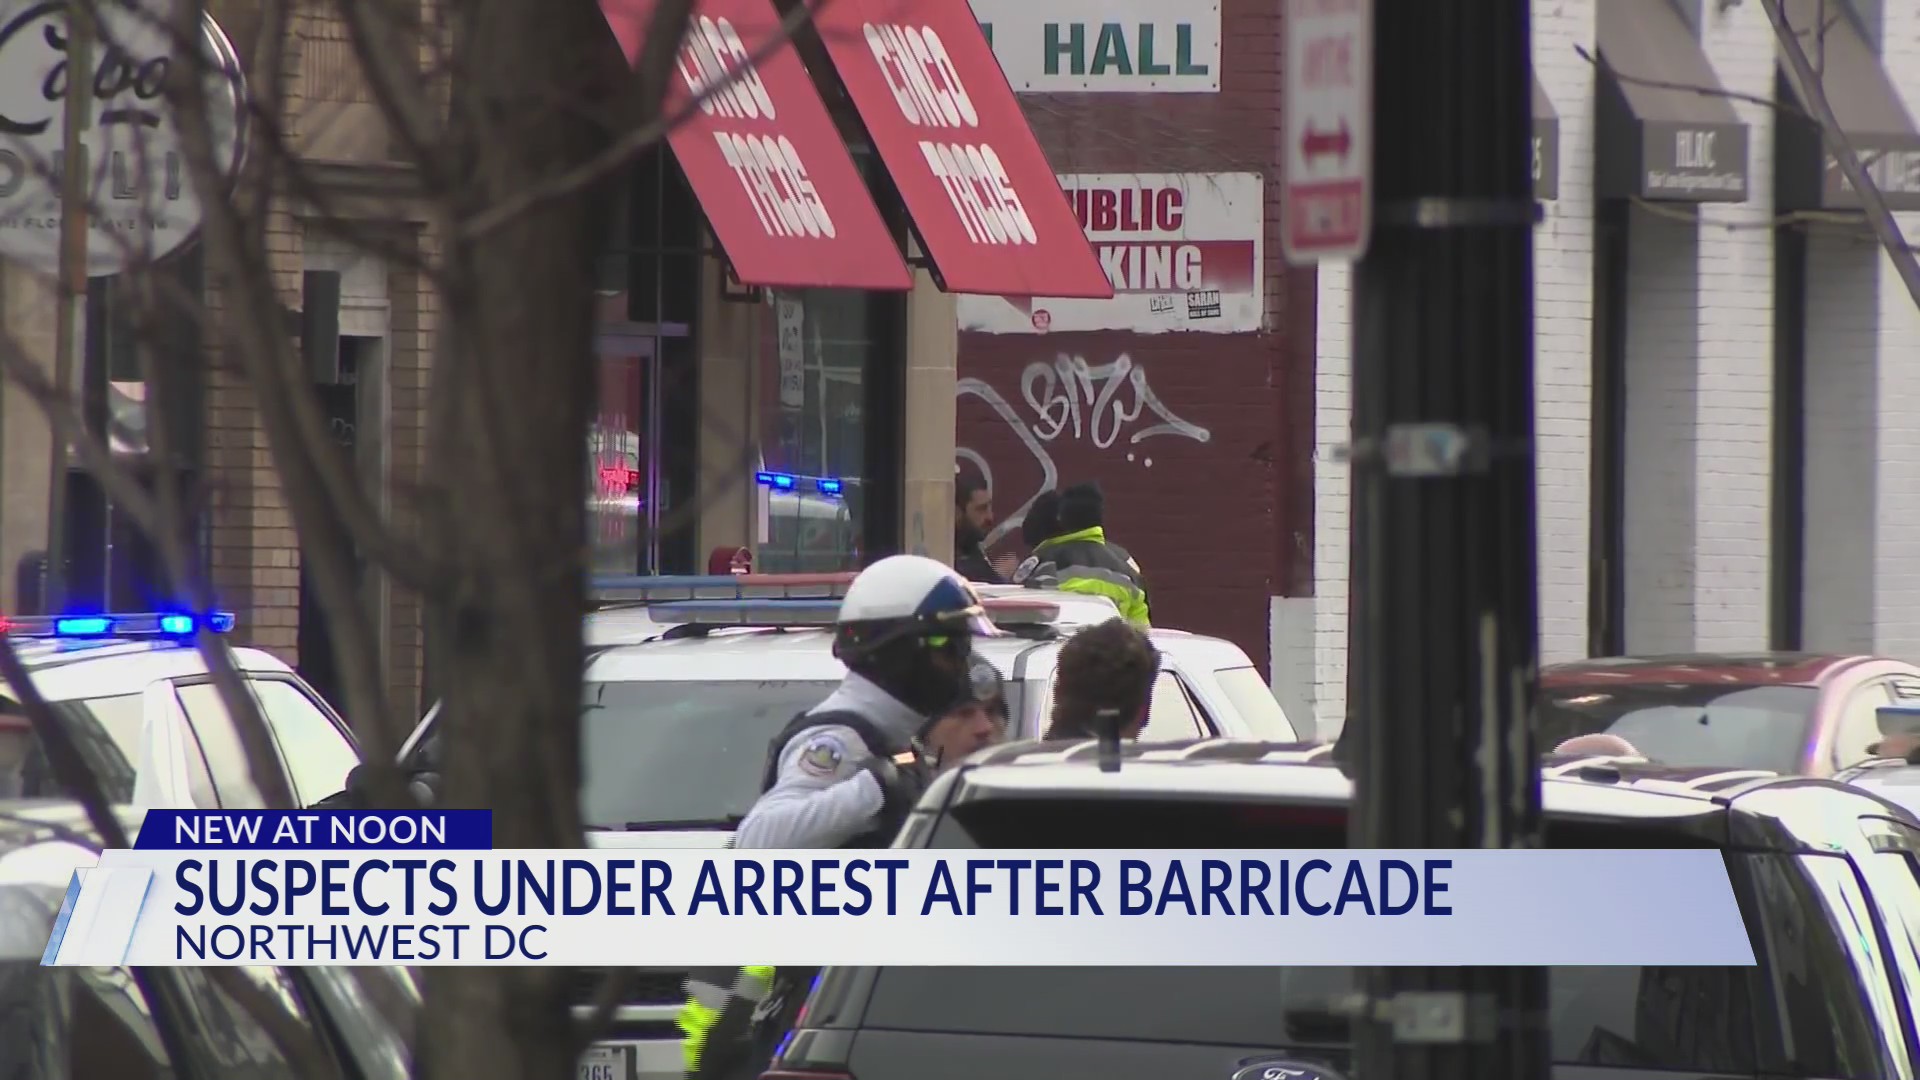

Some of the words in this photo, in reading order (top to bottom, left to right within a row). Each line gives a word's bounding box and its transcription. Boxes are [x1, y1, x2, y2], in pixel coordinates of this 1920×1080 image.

[1044, 23, 1208, 75] HALL
[713, 131, 836, 239] TACOS
[918, 141, 1037, 245] TACOS
[1064, 188, 1183, 231] UBLIC
[1100, 245, 1202, 290] KING
